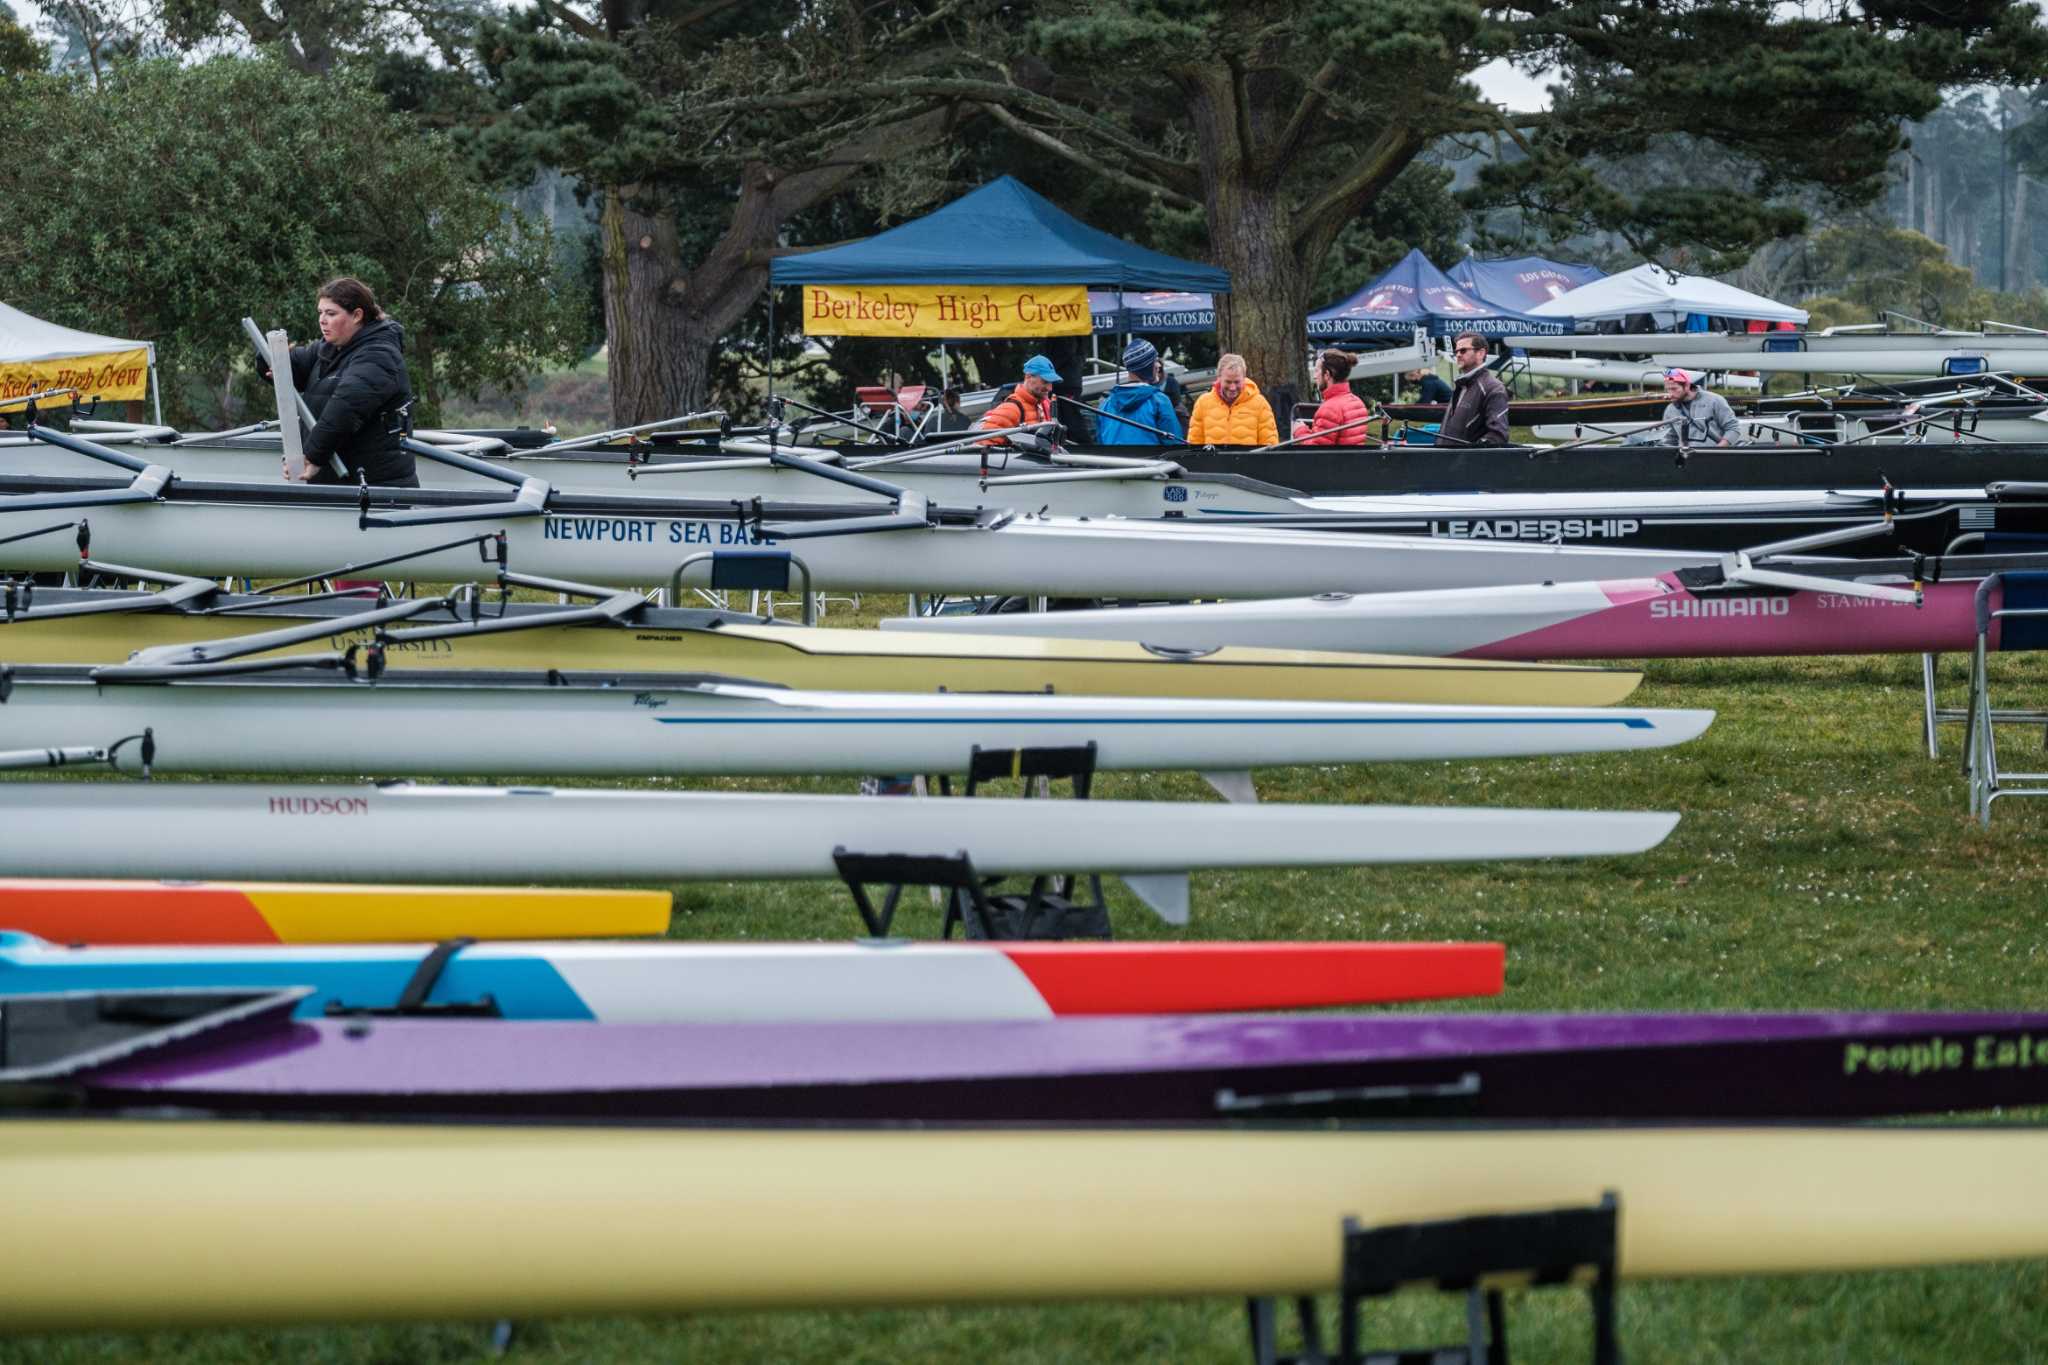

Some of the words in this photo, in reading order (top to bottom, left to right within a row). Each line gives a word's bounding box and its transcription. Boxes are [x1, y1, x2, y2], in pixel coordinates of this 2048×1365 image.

[812, 290, 918, 327] Berkeley
[936, 294, 999, 328] High
[1017, 294, 1081, 322] Crew
[1143, 314, 1161, 326] LOS
[1163, 312, 1197, 326] GATOS
[1334, 320, 1385, 333] ROWING
[1445, 319, 1463, 332] LOS
[1464, 319, 1496, 333] GATOS
[1496, 319, 1537, 334] ROWING
[1539, 322, 1564, 335] CLUB
[55, 367, 94, 390] High
[97, 364, 142, 388] Crew
[544, 517, 656, 542] NEWPORT
[669, 521, 712, 543] SEA
[1431, 519, 1639, 539] LEADERSHIP
[1650, 596, 1790, 618] SHIMANO
[268, 796, 369, 815] HUDSON
[1845, 1037, 1962, 1074] People
